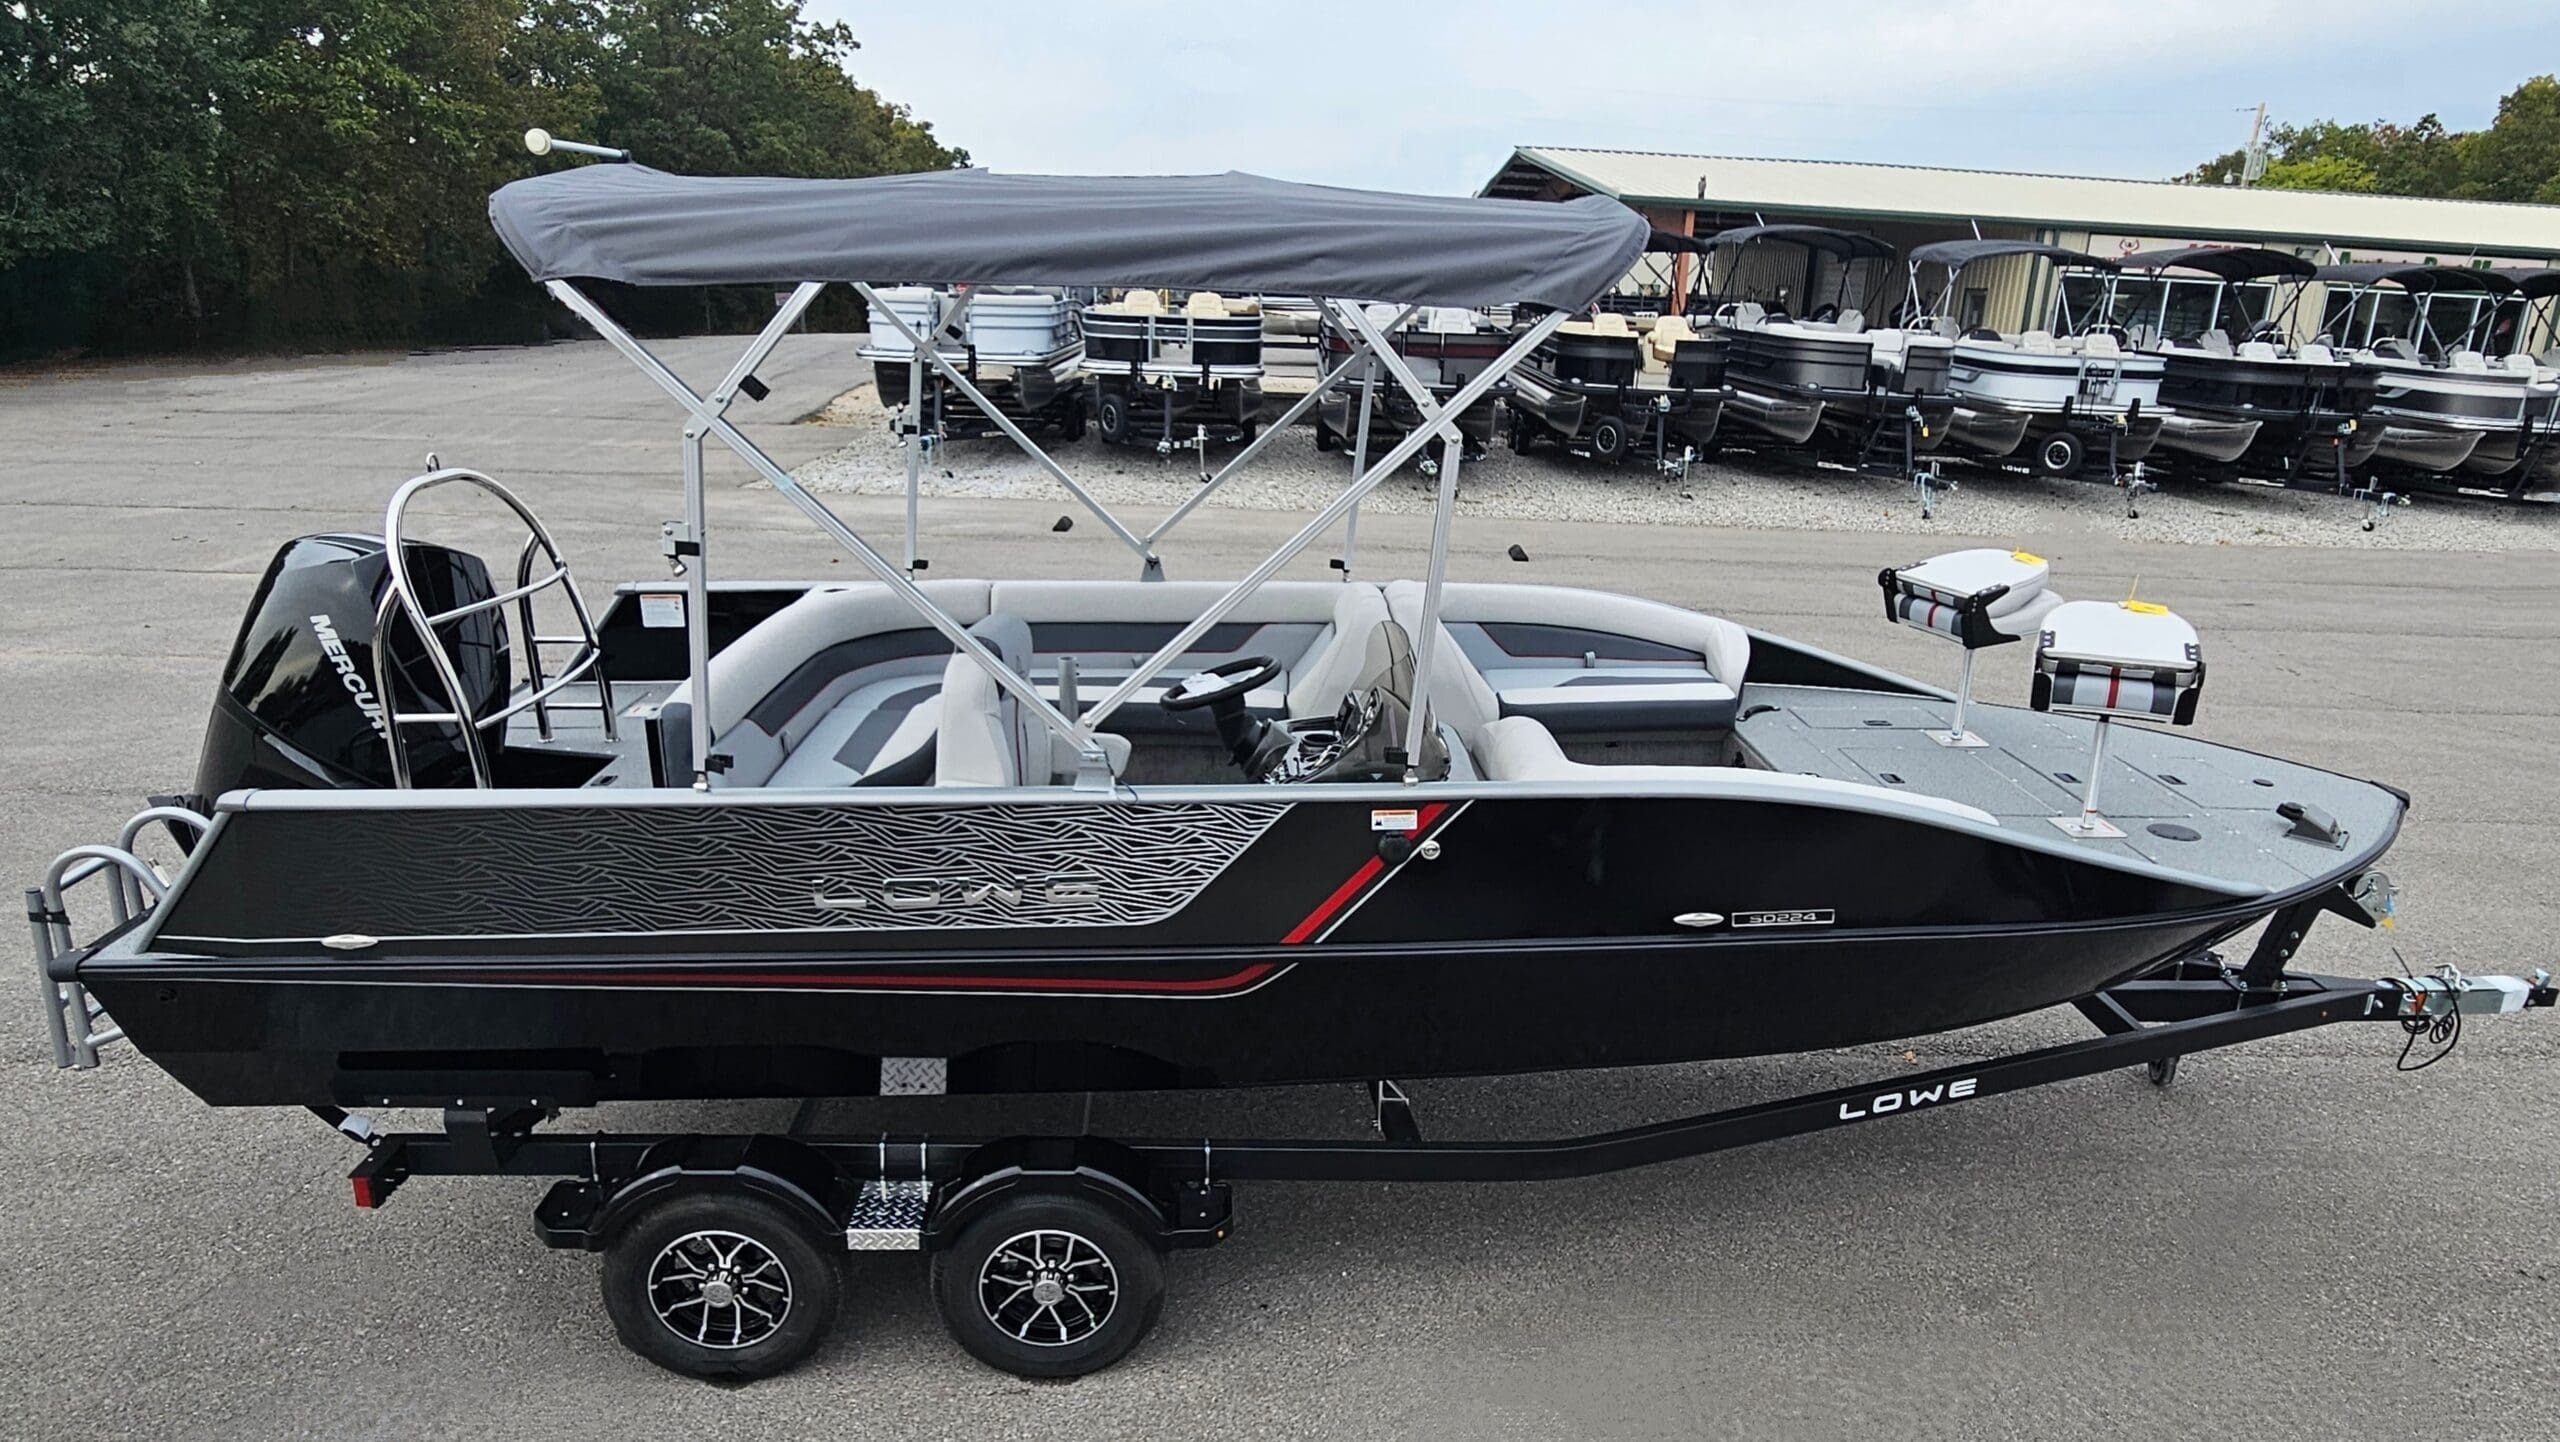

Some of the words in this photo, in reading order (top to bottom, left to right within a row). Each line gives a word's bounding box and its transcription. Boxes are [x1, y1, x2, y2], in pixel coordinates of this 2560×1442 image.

[309, 614, 390, 740] MERCUR
[812, 873, 1100, 909] LOWE
[1839, 1078, 1978, 1120] LOWE
